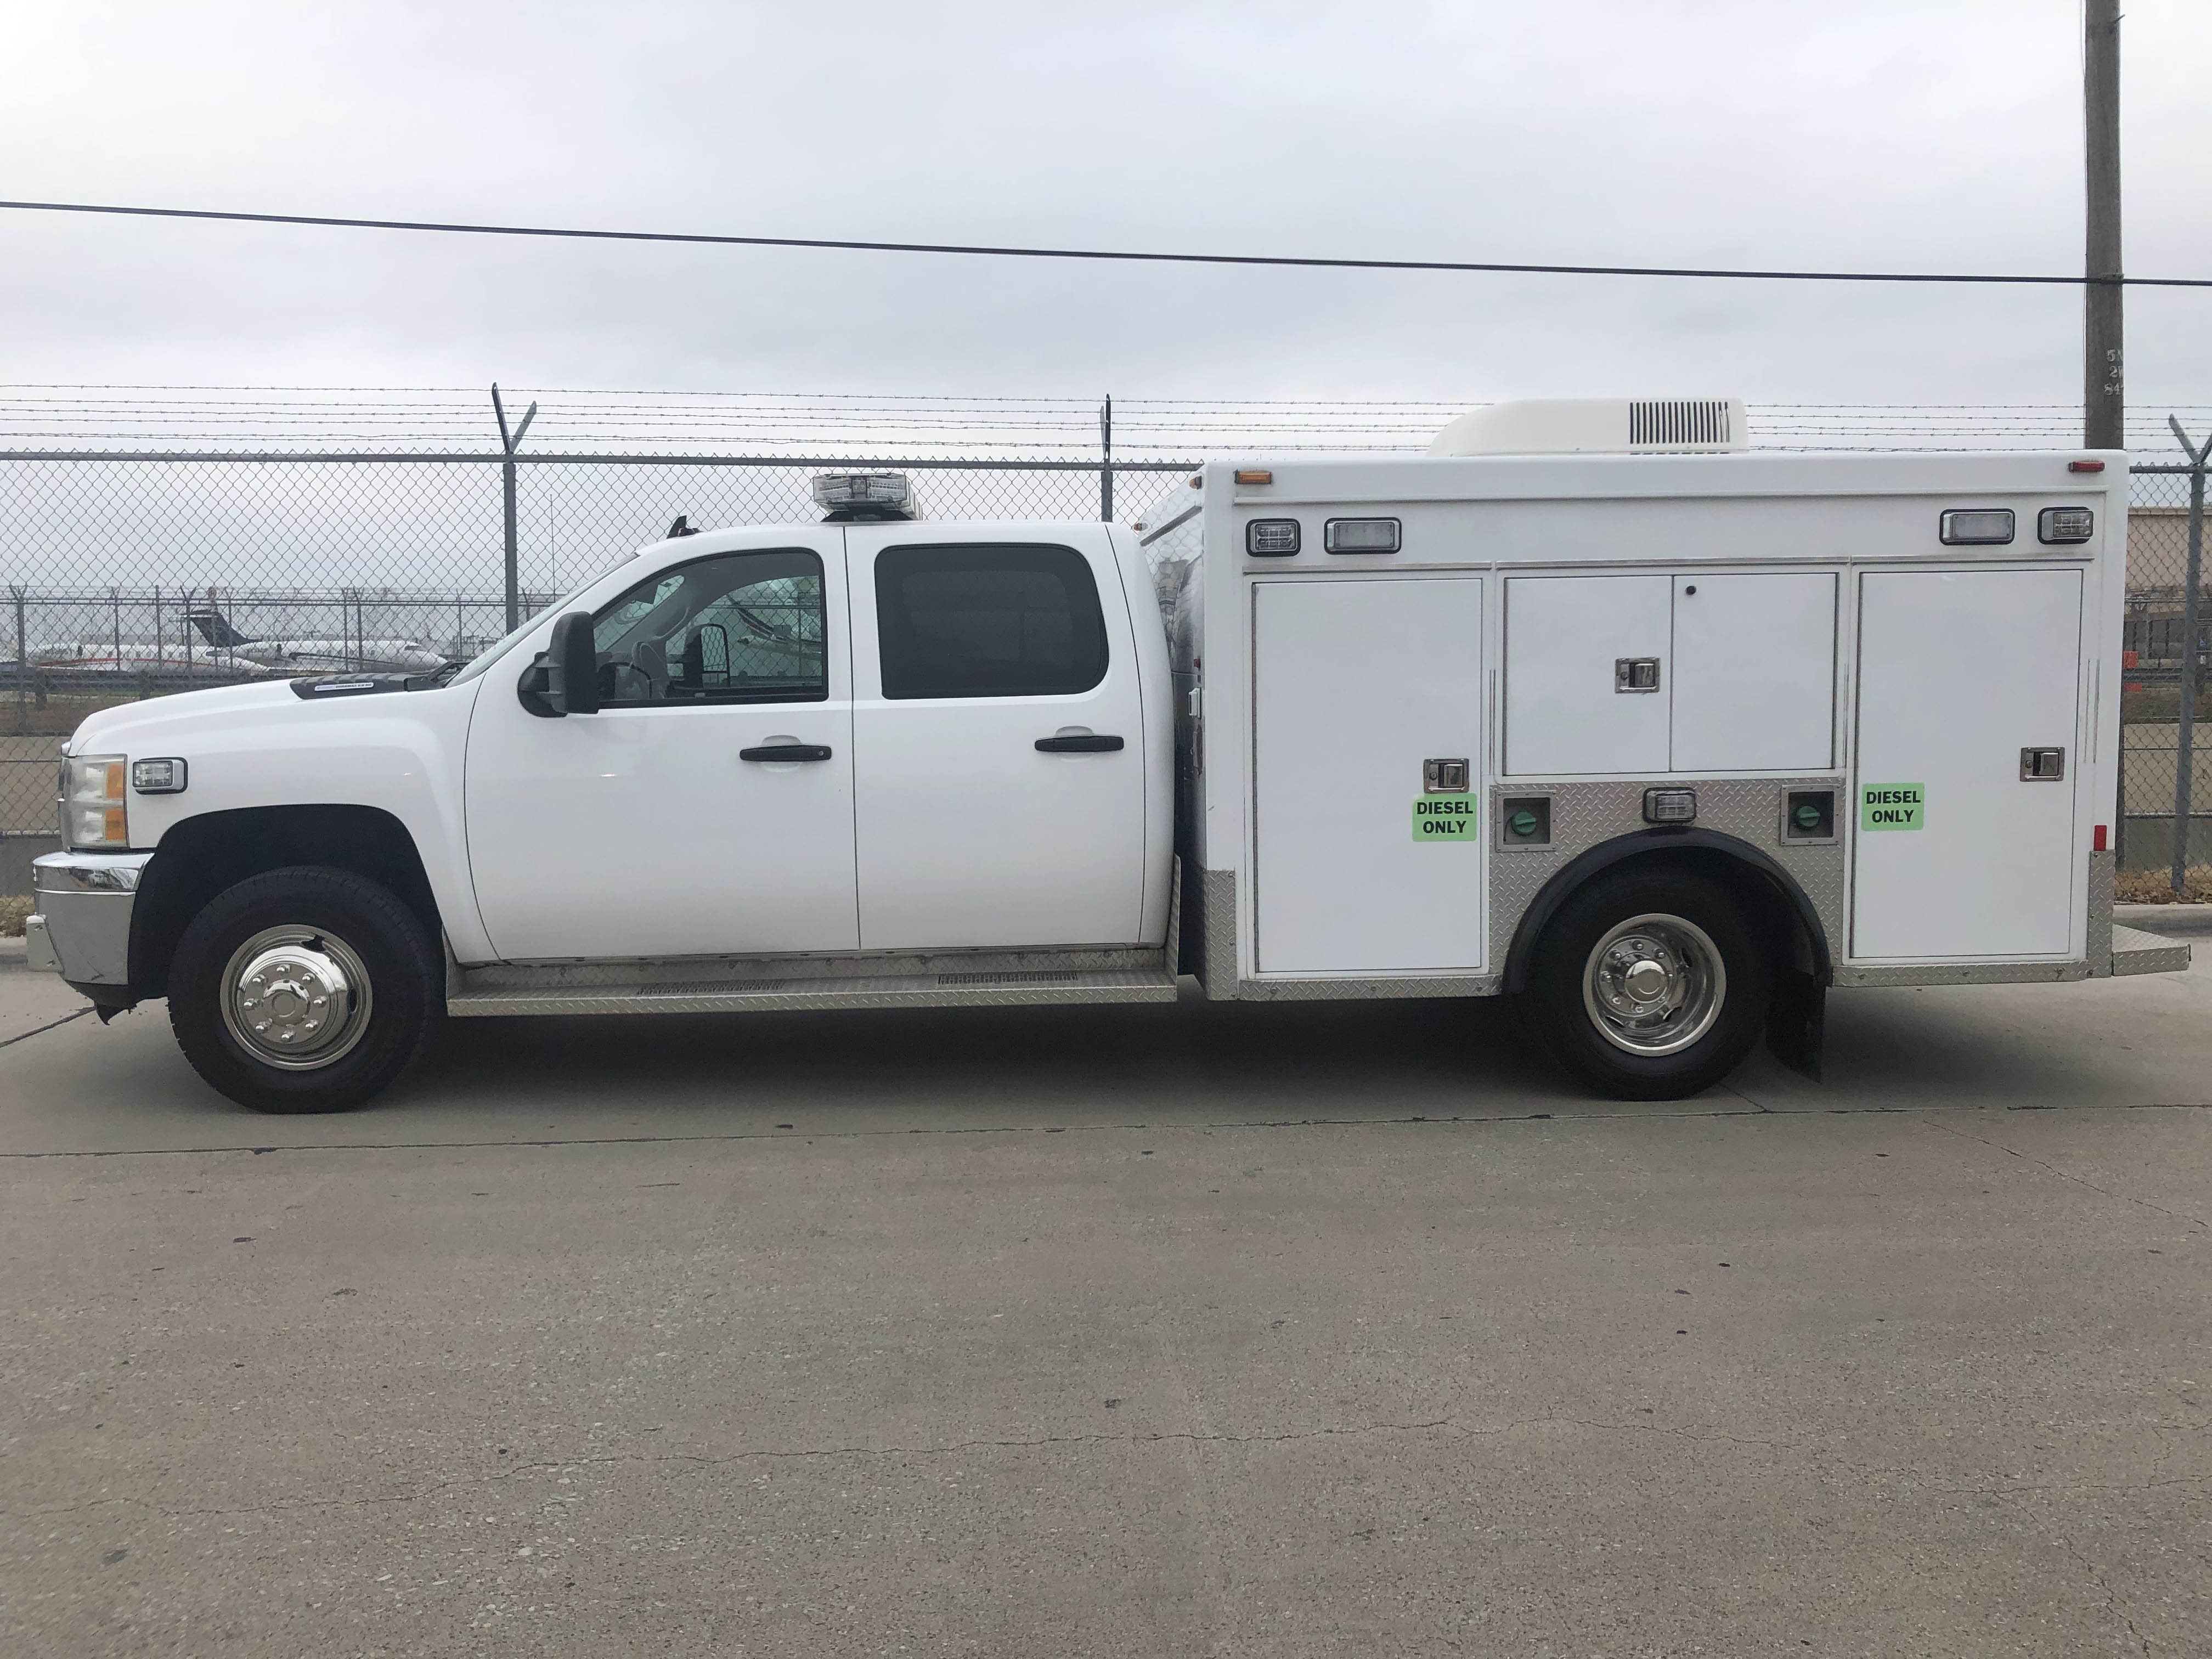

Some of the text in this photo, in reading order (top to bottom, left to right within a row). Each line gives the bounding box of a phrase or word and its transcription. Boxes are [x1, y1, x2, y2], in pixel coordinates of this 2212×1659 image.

[1866, 791, 1921, 804] DIESEL
[1417, 801, 1474, 815] DIESEL
[1872, 810, 1914, 823] ONLY
[1423, 820, 1466, 833] ONLY
